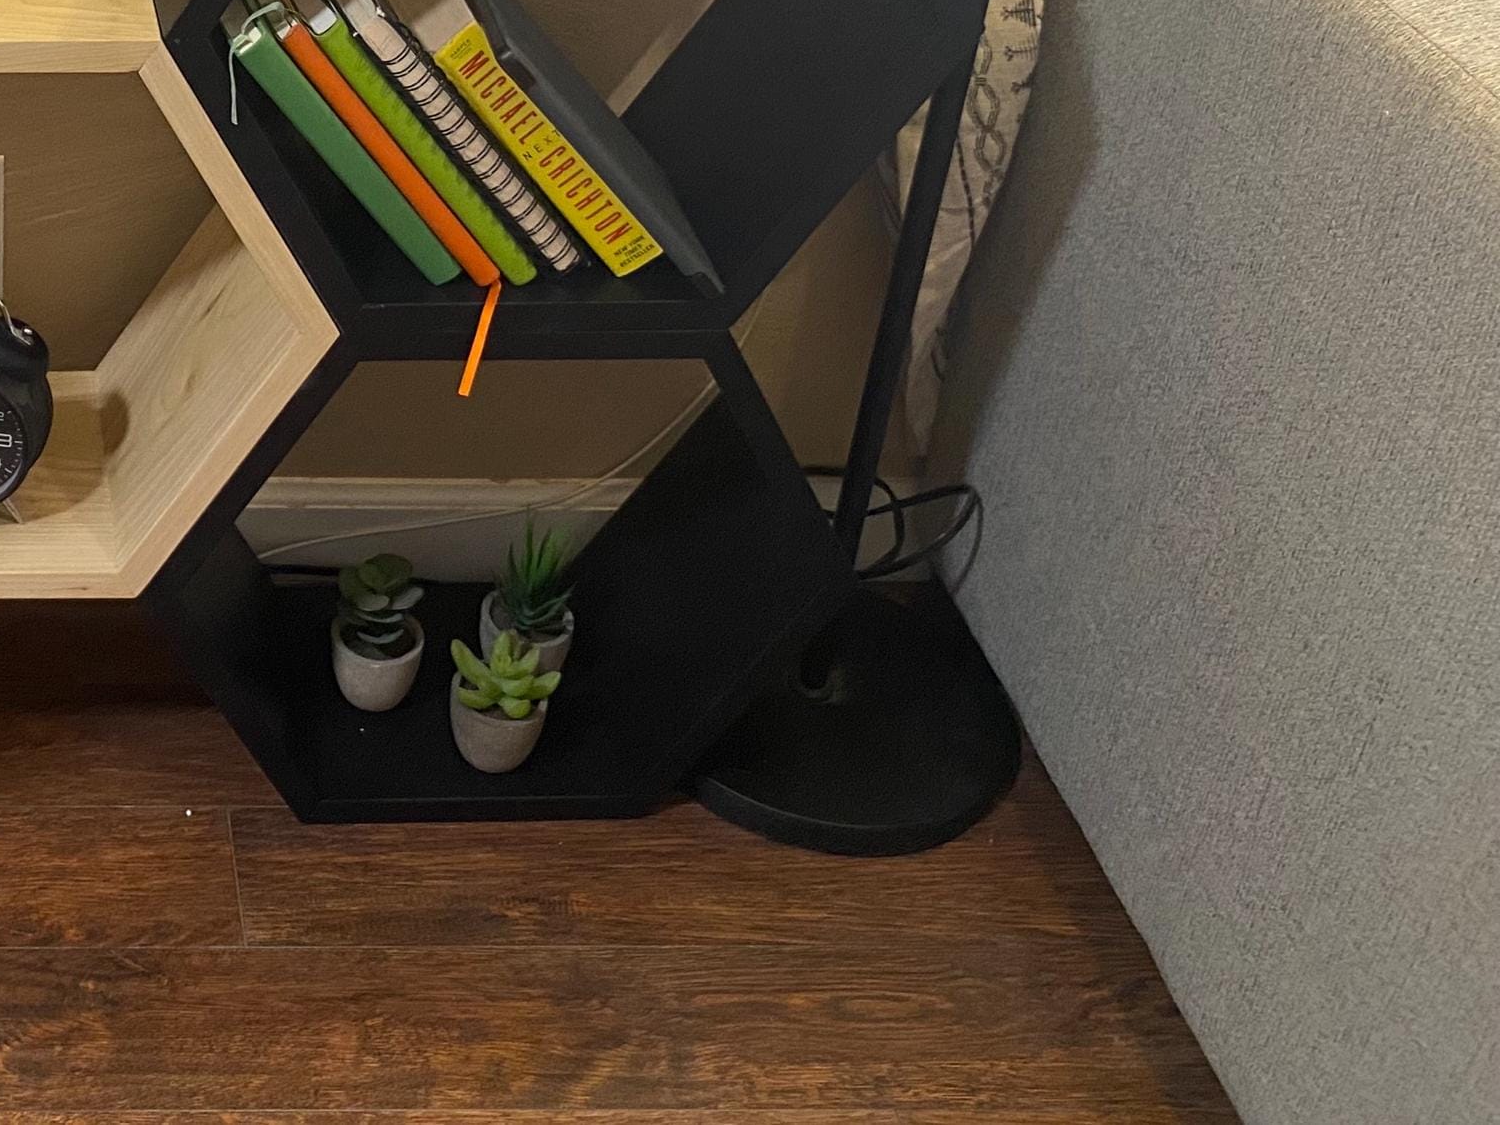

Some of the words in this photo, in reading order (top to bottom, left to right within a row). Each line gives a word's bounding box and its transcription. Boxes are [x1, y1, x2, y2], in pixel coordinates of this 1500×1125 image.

[458, 50, 544, 145] MICHAEL
[539, 145, 633, 245] CRICHTON
[522, 129, 560, 161] NEXT
